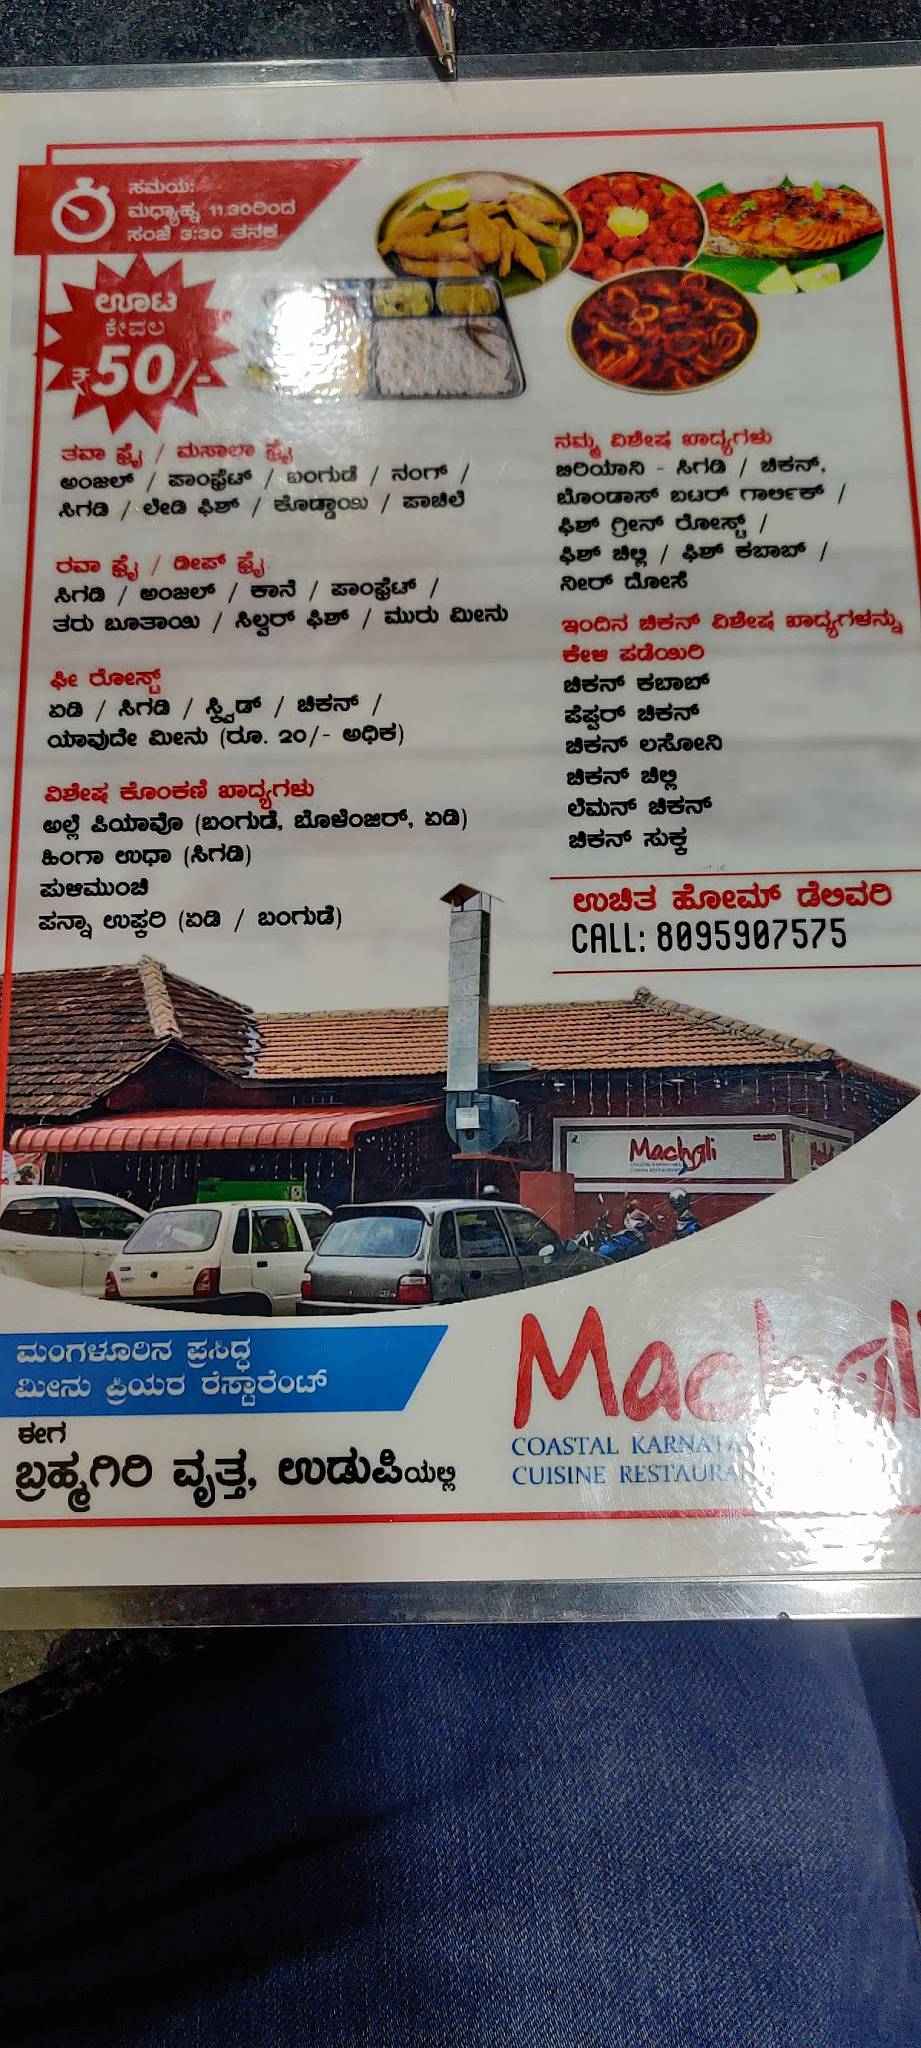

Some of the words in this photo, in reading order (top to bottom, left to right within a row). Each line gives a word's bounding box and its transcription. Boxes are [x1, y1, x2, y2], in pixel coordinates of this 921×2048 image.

[127, 226, 171, 242] ಸಂಜೆ
[231, 223, 279, 239] ತನಕ
[95, 291, 178, 313] ಊಟ
[105, 318, 165, 337] ಕೇವಲ
[61, 444, 106, 461] ತವಾ
[155, 443, 165, 464] /
[177, 442, 255, 459] ಮಸಾಲಾ
[554, 432, 601, 459] ನಮ್ಮ
[610, 430, 671, 449] ವಿಶೇಷ
[682, 427, 772, 457] ಖಾದ್ಯಗಳು
[60, 472, 134, 489] ಅಂಜಲ್
[146, 471, 156, 492] /
[264, 468, 274, 489] /
[287, 465, 357, 483] ಬಂಗುಡೆ
[369, 465, 379, 487] /
[392, 463, 448, 482] ನಂಗ್
[460, 463, 469, 484] /
[555, 459, 645, 477] ಬಿರಿಯಾನಿ
[676, 457, 727, 475] ಸಿಗಡಿ
[739, 457, 747, 478] /
[58, 500, 109, 518] ಸಿಗಡಿ
[120, 500, 131, 521] /
[143, 498, 187, 515] ಲೇಡಿ
[197, 496, 240, 516] ಫಿಶ್
[251, 496, 262, 518] /
[381, 493, 390, 514] /
[556, 487, 659, 505] ಬೊಂಡಾಸ್
[670, 486, 729, 503] ಬಟರ್
[837, 483, 846, 504] /
[558, 516, 600, 536] ಫಿಶ್
[611, 515, 664, 537] ಗ್ರೀನ್
[675, 513, 747, 539] ರೋಸ್ಟ್
[759, 513, 768, 534] /
[56, 556, 101, 574] ರವಾ
[151, 554, 161, 576] /
[173, 553, 226, 571] ಡೀಪ್
[559, 545, 601, 566] ಫಿಶ್
[660, 544, 668, 565] /
[682, 543, 724, 563] ಫಿಶ್
[735, 541, 806, 558] ಕಬಾಬ್
[820, 541, 828, 562] /
[54, 585, 105, 604] ಸಿಗಡಿ
[117, 585, 128, 607] /
[140, 583, 216, 601] ಅಂಜಲ್
[228, 582, 238, 604] /
[250, 579, 296, 598] ಕಾನೆ
[309, 580, 318, 602] /
[429, 577, 439, 599] /
[560, 574, 613, 591] ನೀರ್
[624, 570, 688, 590] ದೋಸೆ
[52, 613, 94, 633] ತರು
[104, 613, 200, 631] ಬೂತಾಯಿ
[212, 612, 223, 634] /
[235, 610, 295, 637] ಸಿಲ್ವರ್
[306, 608, 349, 630] ಫಿಶ್
[362, 608, 372, 631] /
[384, 605, 439, 625] ಮುರು
[449, 603, 508, 624] ಮೀನು
[562, 613, 628, 634] ಇಂದಿನ
[639, 612, 700, 631] ಚಿಕನ್
[711, 610, 775, 631] ವಿಶೇಷ
[786, 609, 904, 638] ಖಾದ್ಯಗಳನ್ನು
[562, 644, 608, 663] ಕೇಳಿ
[619, 643, 705, 662] ಪಡೆಯಿರಿ
[89, 668, 161, 695] ರೋಸ್ಟ್
[563, 674, 625, 693] ಚಿಕನ್
[637, 673, 710, 691] ಕಬಾಬ್
[49, 700, 83, 718] ಏಡಿ
[95, 699, 106, 723] /
[118, 698, 170, 716] ಸಿಗಡಿ
[183, 697, 193, 720] /
[274, 695, 285, 719] /
[297, 694, 359, 713] ಚಿಕನ್
[372, 693, 382, 716] /
[564, 704, 626, 731] ಪೆಪ್ಪರ್
[637, 703, 700, 722] ಚಿಕನ್
[47, 728, 137, 751] ಯಾವುದೇ
[149, 727, 208, 746] ಮೀನು
[220, 725, 268, 749] (ರೂ.
[343, 722, 404, 747] ಅಧಿಕ)
[565, 734, 628, 754] ಚಿಕನ್
[639, 732, 723, 752] ಲಸೋನಿ
[566, 766, 629, 786] ಚಿಕನ್
[44, 782, 109, 804] ವಿಶೇಷ
[218, 778, 314, 810] ಖಾದ್ಯಗಳು
[568, 797, 638, 817] ಲೆಮನ್
[648, 795, 713, 816] ಚಿಕನ್
[43, 814, 80, 840] ಅಲ್ಲೆ
[195, 809, 283, 836] (ಬಂಗುಡೆ,
[424, 808, 467, 831] ಏಡಿ)
[568, 828, 632, 848] ಚಿಕನ್
[643, 827, 688, 856] ಸುಕ್ಕ
[41, 849, 104, 866] ಹಿಂಗಾ
[184, 843, 251, 868] (ಸಿಗಡಿ)
[39, 877, 149, 898] ಪುಳಿಮುಂಚಿ
[573, 884, 657, 913] ಉಚಿತ
[672, 883, 782, 911] ಹೋಮ್
[796, 880, 893, 908] ಡೆಲಿವರಿ
[103, 909, 166, 938] ಉಪ್ಕರಿ
[178, 909, 221, 933] (ಏಡಿ
[234, 908, 244, 933] /
[257, 905, 342, 930] ಬಂಗುಡೆ)
[572, 922, 645, 953] CALL:
[657, 918, 847, 951] 8095907575
[630, 1135, 717, 1172] Machali
[16, 1338, 173, 1364] ಮಂಗಳೂರಿನ
[186, 1338, 251, 1372] ಪ್ರಸಿದ್ಧ
[15, 1374, 92, 1399] ಮೀನು
[106, 1372, 186, 1405] ಪ್ರಿಯರ
[201, 1368, 327, 1407] ರೆಸ್ಟಾರೆಂಟ್
[17, 1421, 66, 1444] ಈಗ
[511, 1436, 619, 1456] COASTAL
[15, 1450, 153, 1513] ಬ್ರಹ್ಮಗಿರಿ
[173, 1449, 257, 1508] ವೃತ್ತ,
[278, 1446, 456, 1492] ಉಡುಪಿಯಲ್ಲಿ
[511, 1465, 606, 1486] CUISINE
